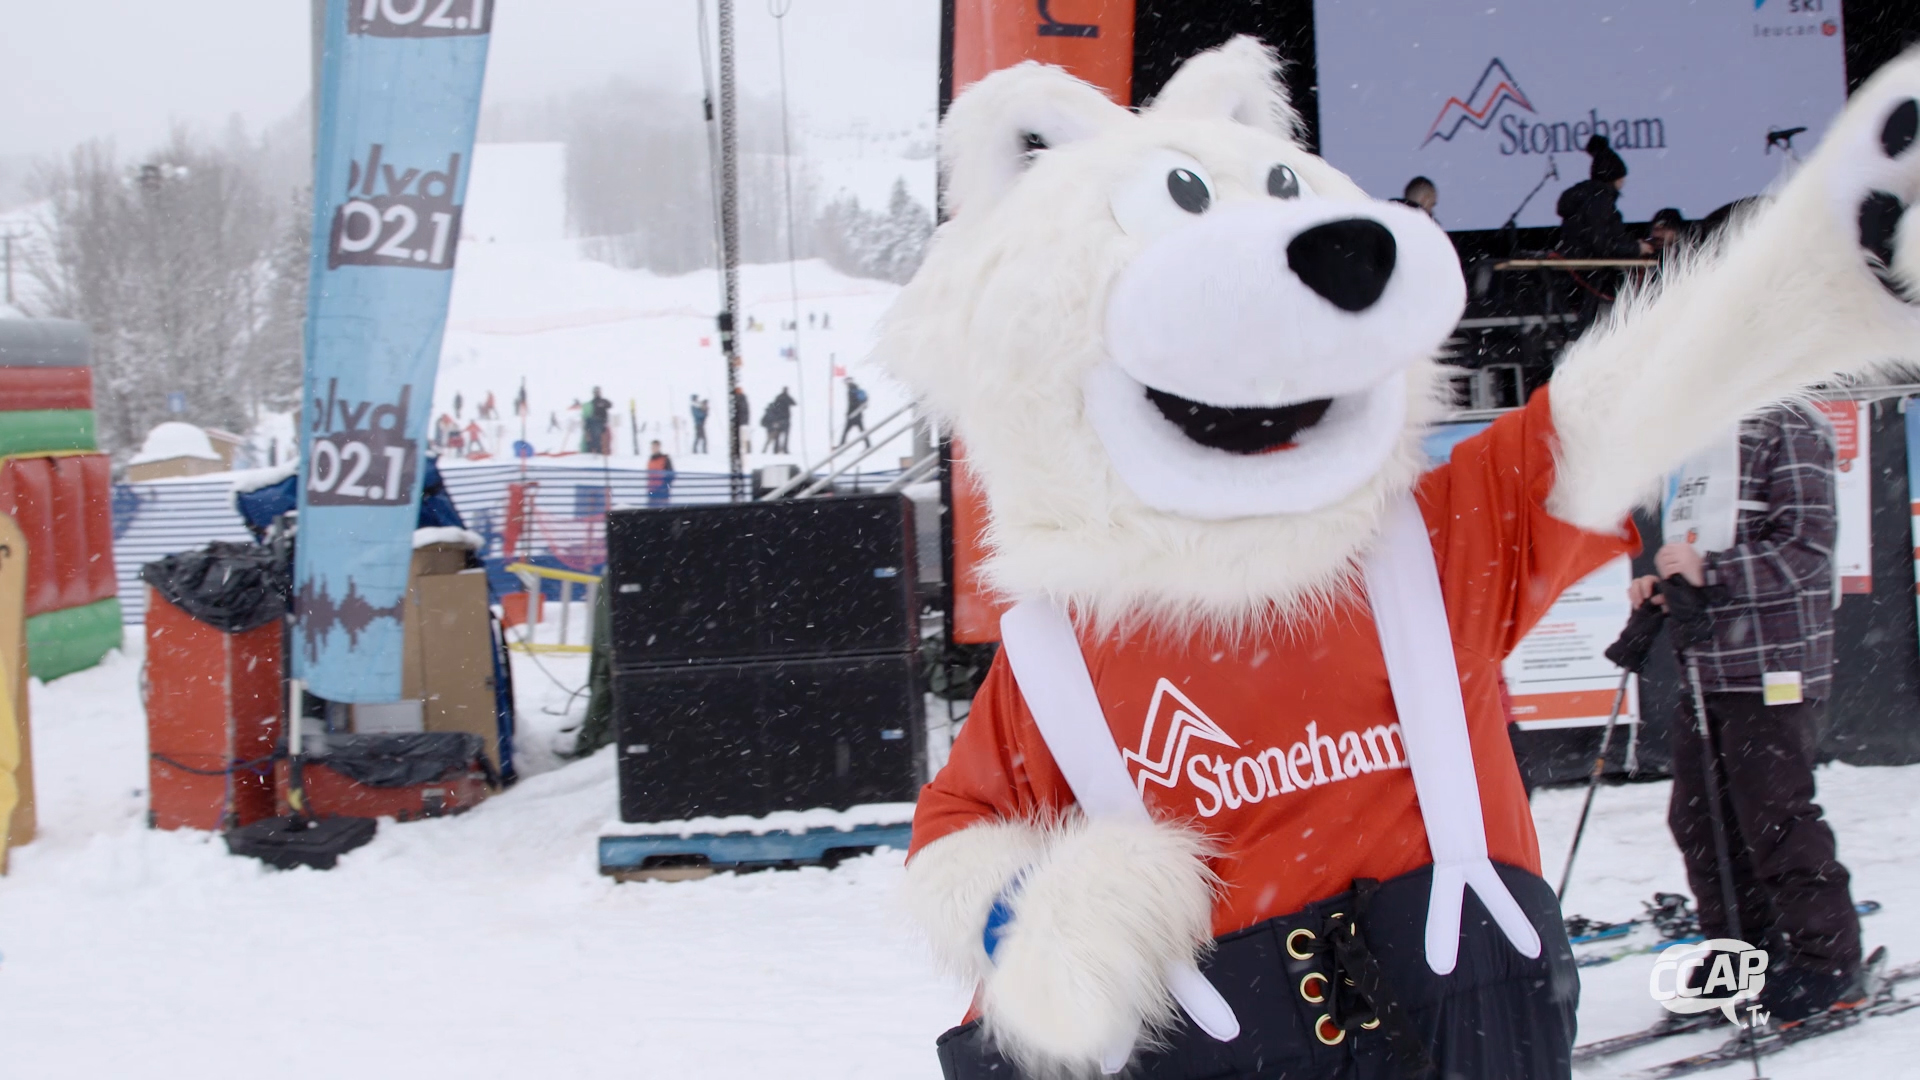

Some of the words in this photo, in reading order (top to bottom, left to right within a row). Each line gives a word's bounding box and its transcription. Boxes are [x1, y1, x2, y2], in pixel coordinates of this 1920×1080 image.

[1500, 108, 1667, 155] Stoneham
[338, 201, 452, 264] 02.1
[306, 439, 405, 500] 02.1
[1187, 720, 1410, 817] Stoneham
